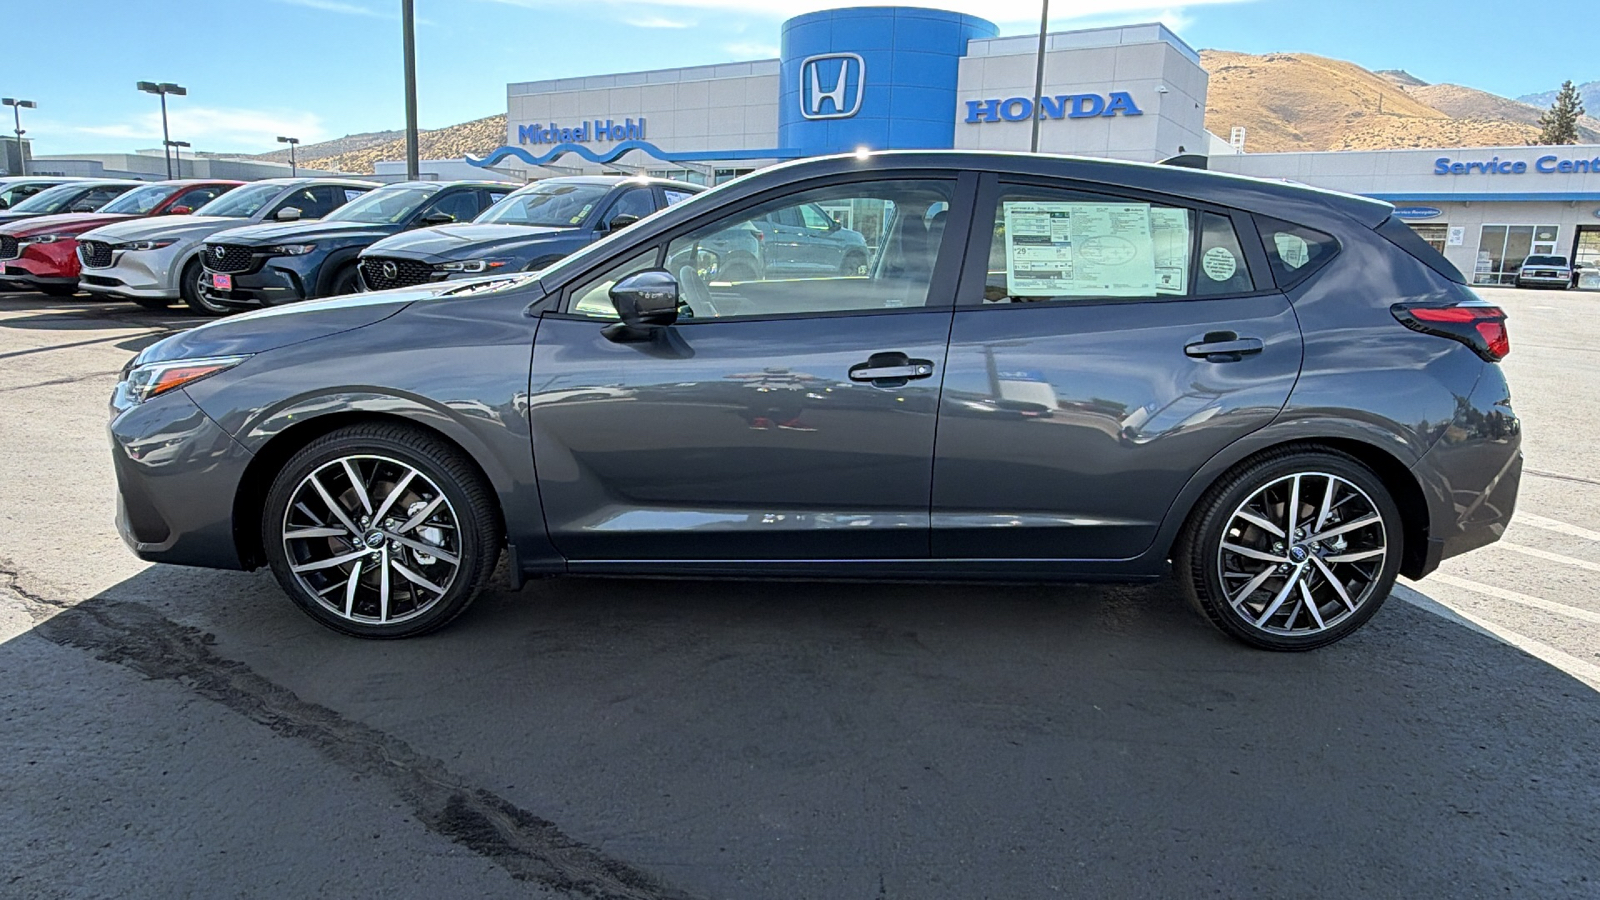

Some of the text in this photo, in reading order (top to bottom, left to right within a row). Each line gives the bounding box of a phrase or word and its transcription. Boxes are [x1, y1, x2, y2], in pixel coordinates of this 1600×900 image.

[964, 91, 1143, 123] HONDA
[518, 117, 647, 145] Michael Hohl
[1434, 156, 1527, 175] Service
